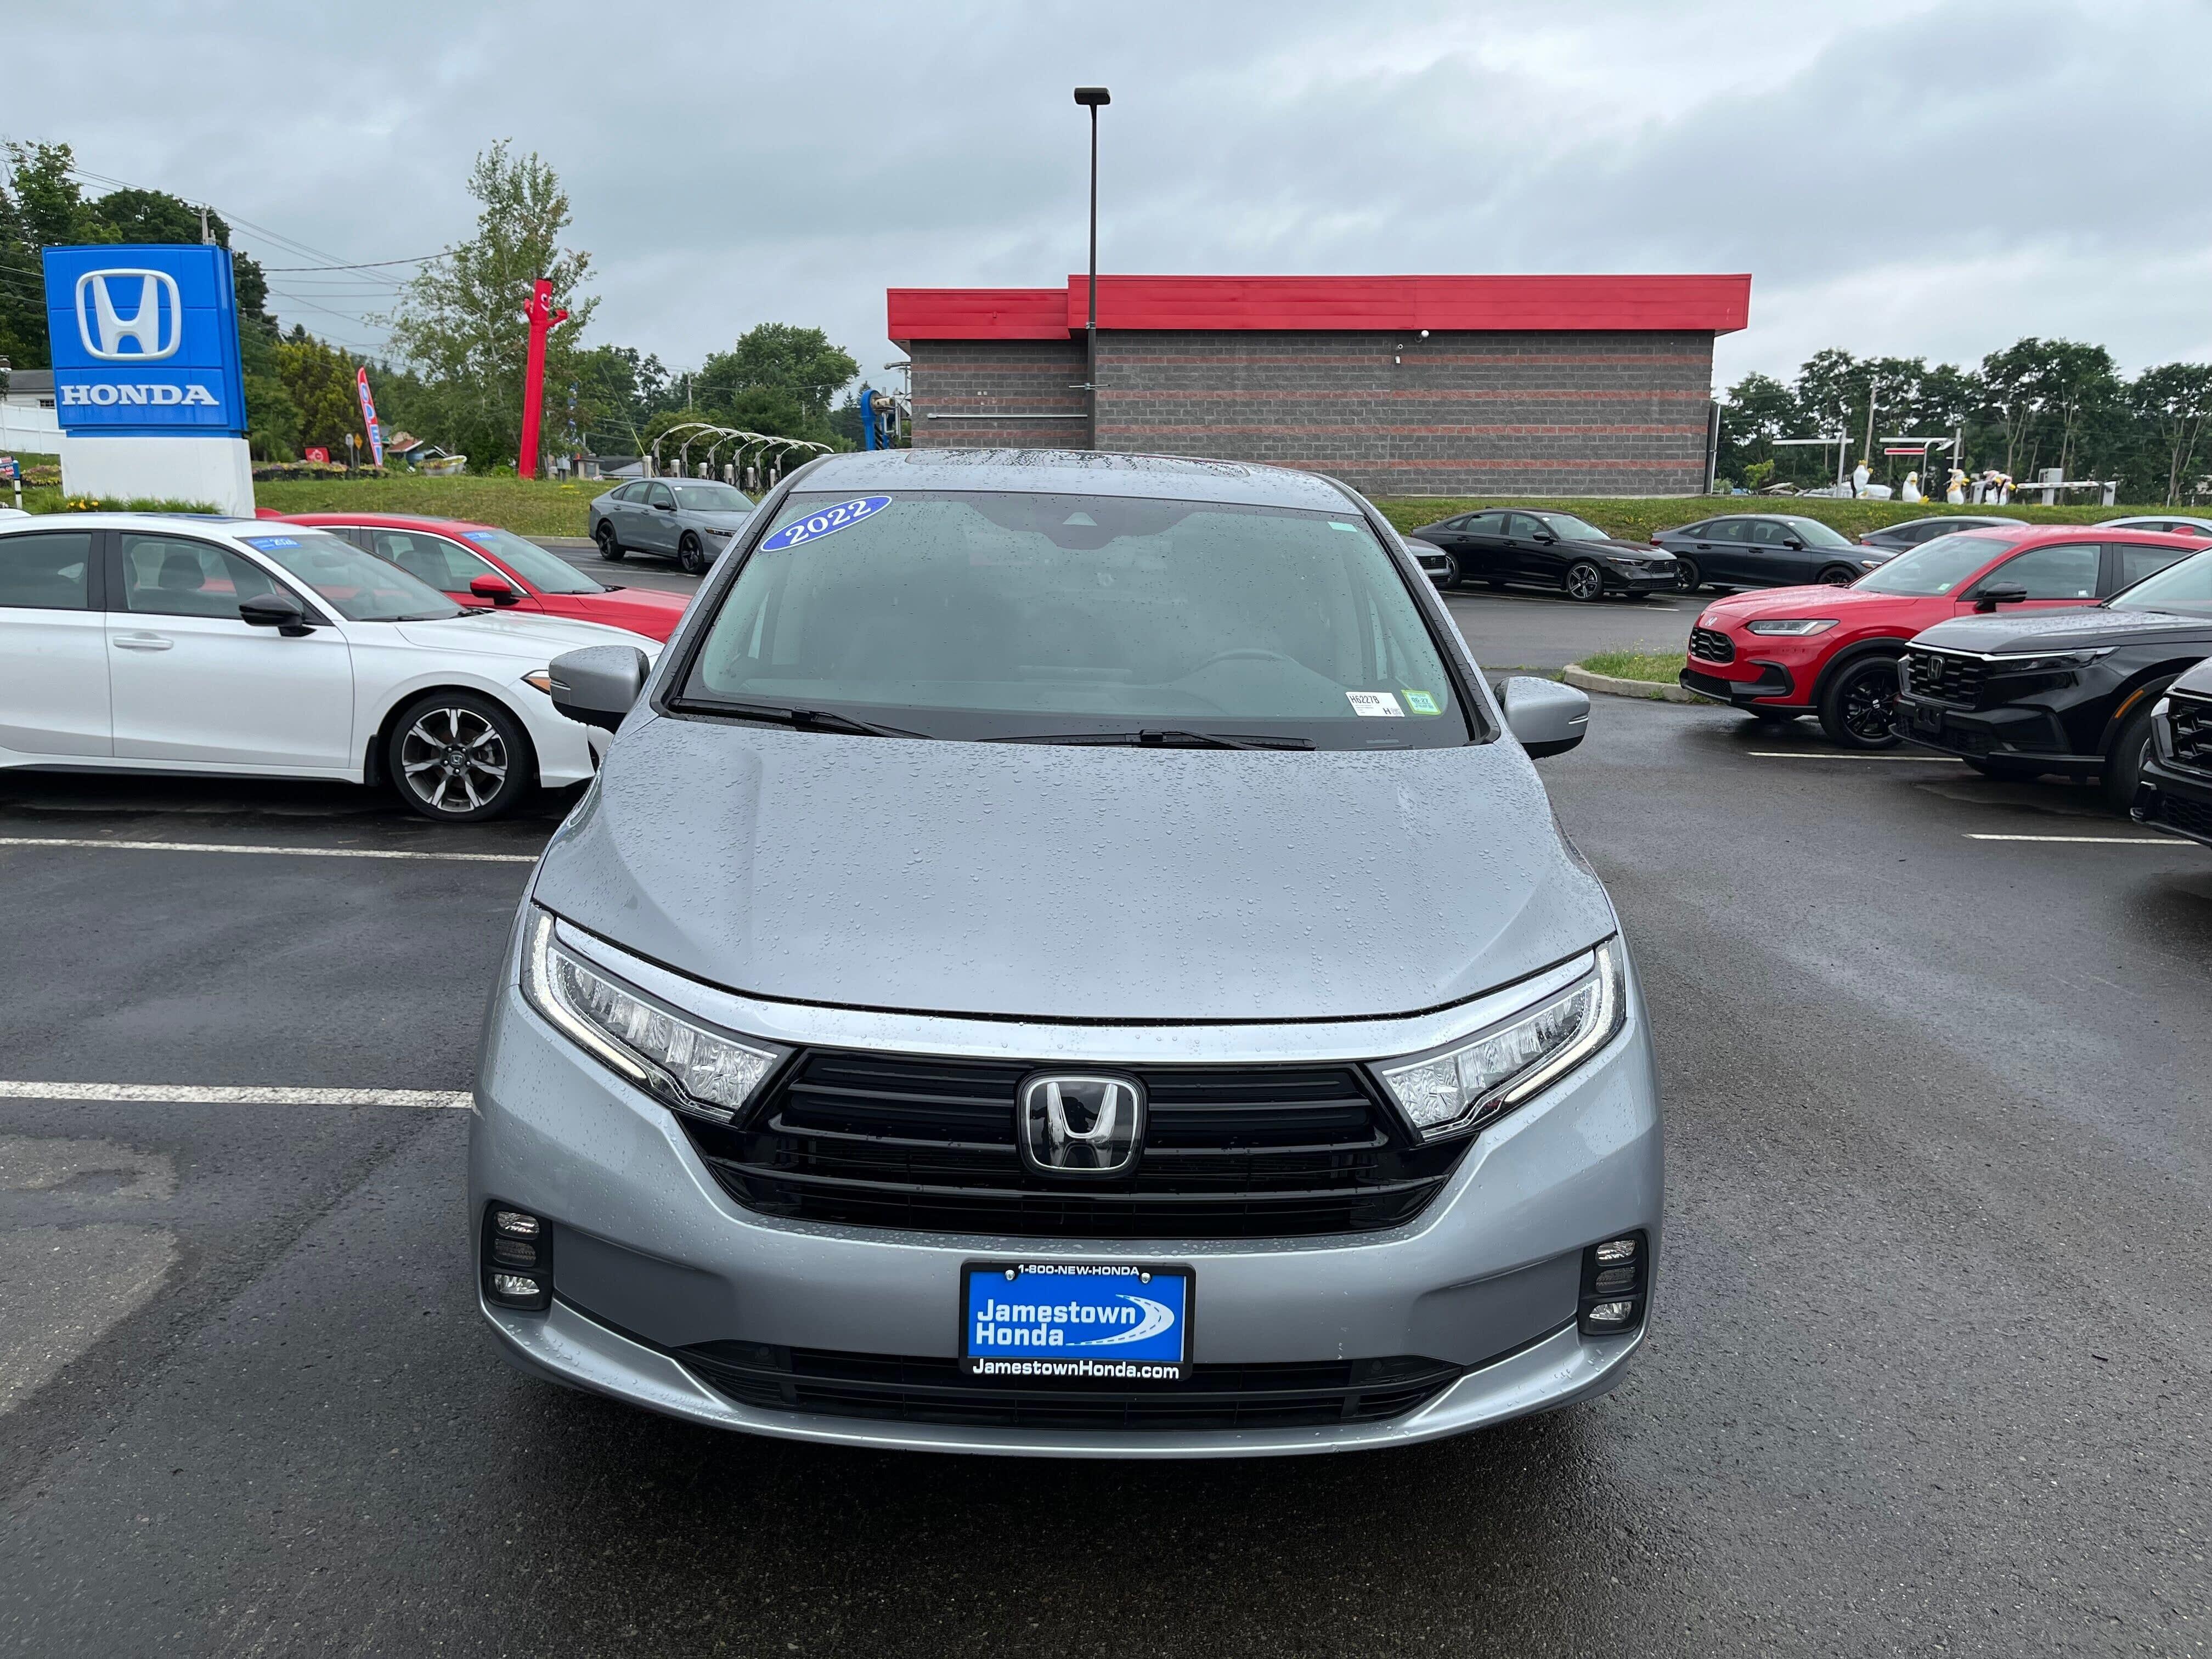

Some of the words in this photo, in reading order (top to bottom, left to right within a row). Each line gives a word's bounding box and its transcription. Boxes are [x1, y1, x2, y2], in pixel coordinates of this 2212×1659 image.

[60, 384, 219, 406] HONDA
[785, 500, 872, 545] 2022
[1018, 1264, 1140, 1276] 1-800-NEW-HONDA
[977, 1299, 1136, 1324] Jamestown
[976, 1322, 1064, 1347] Honda
[972, 1358, 1180, 1380] JamestownHonda.com
